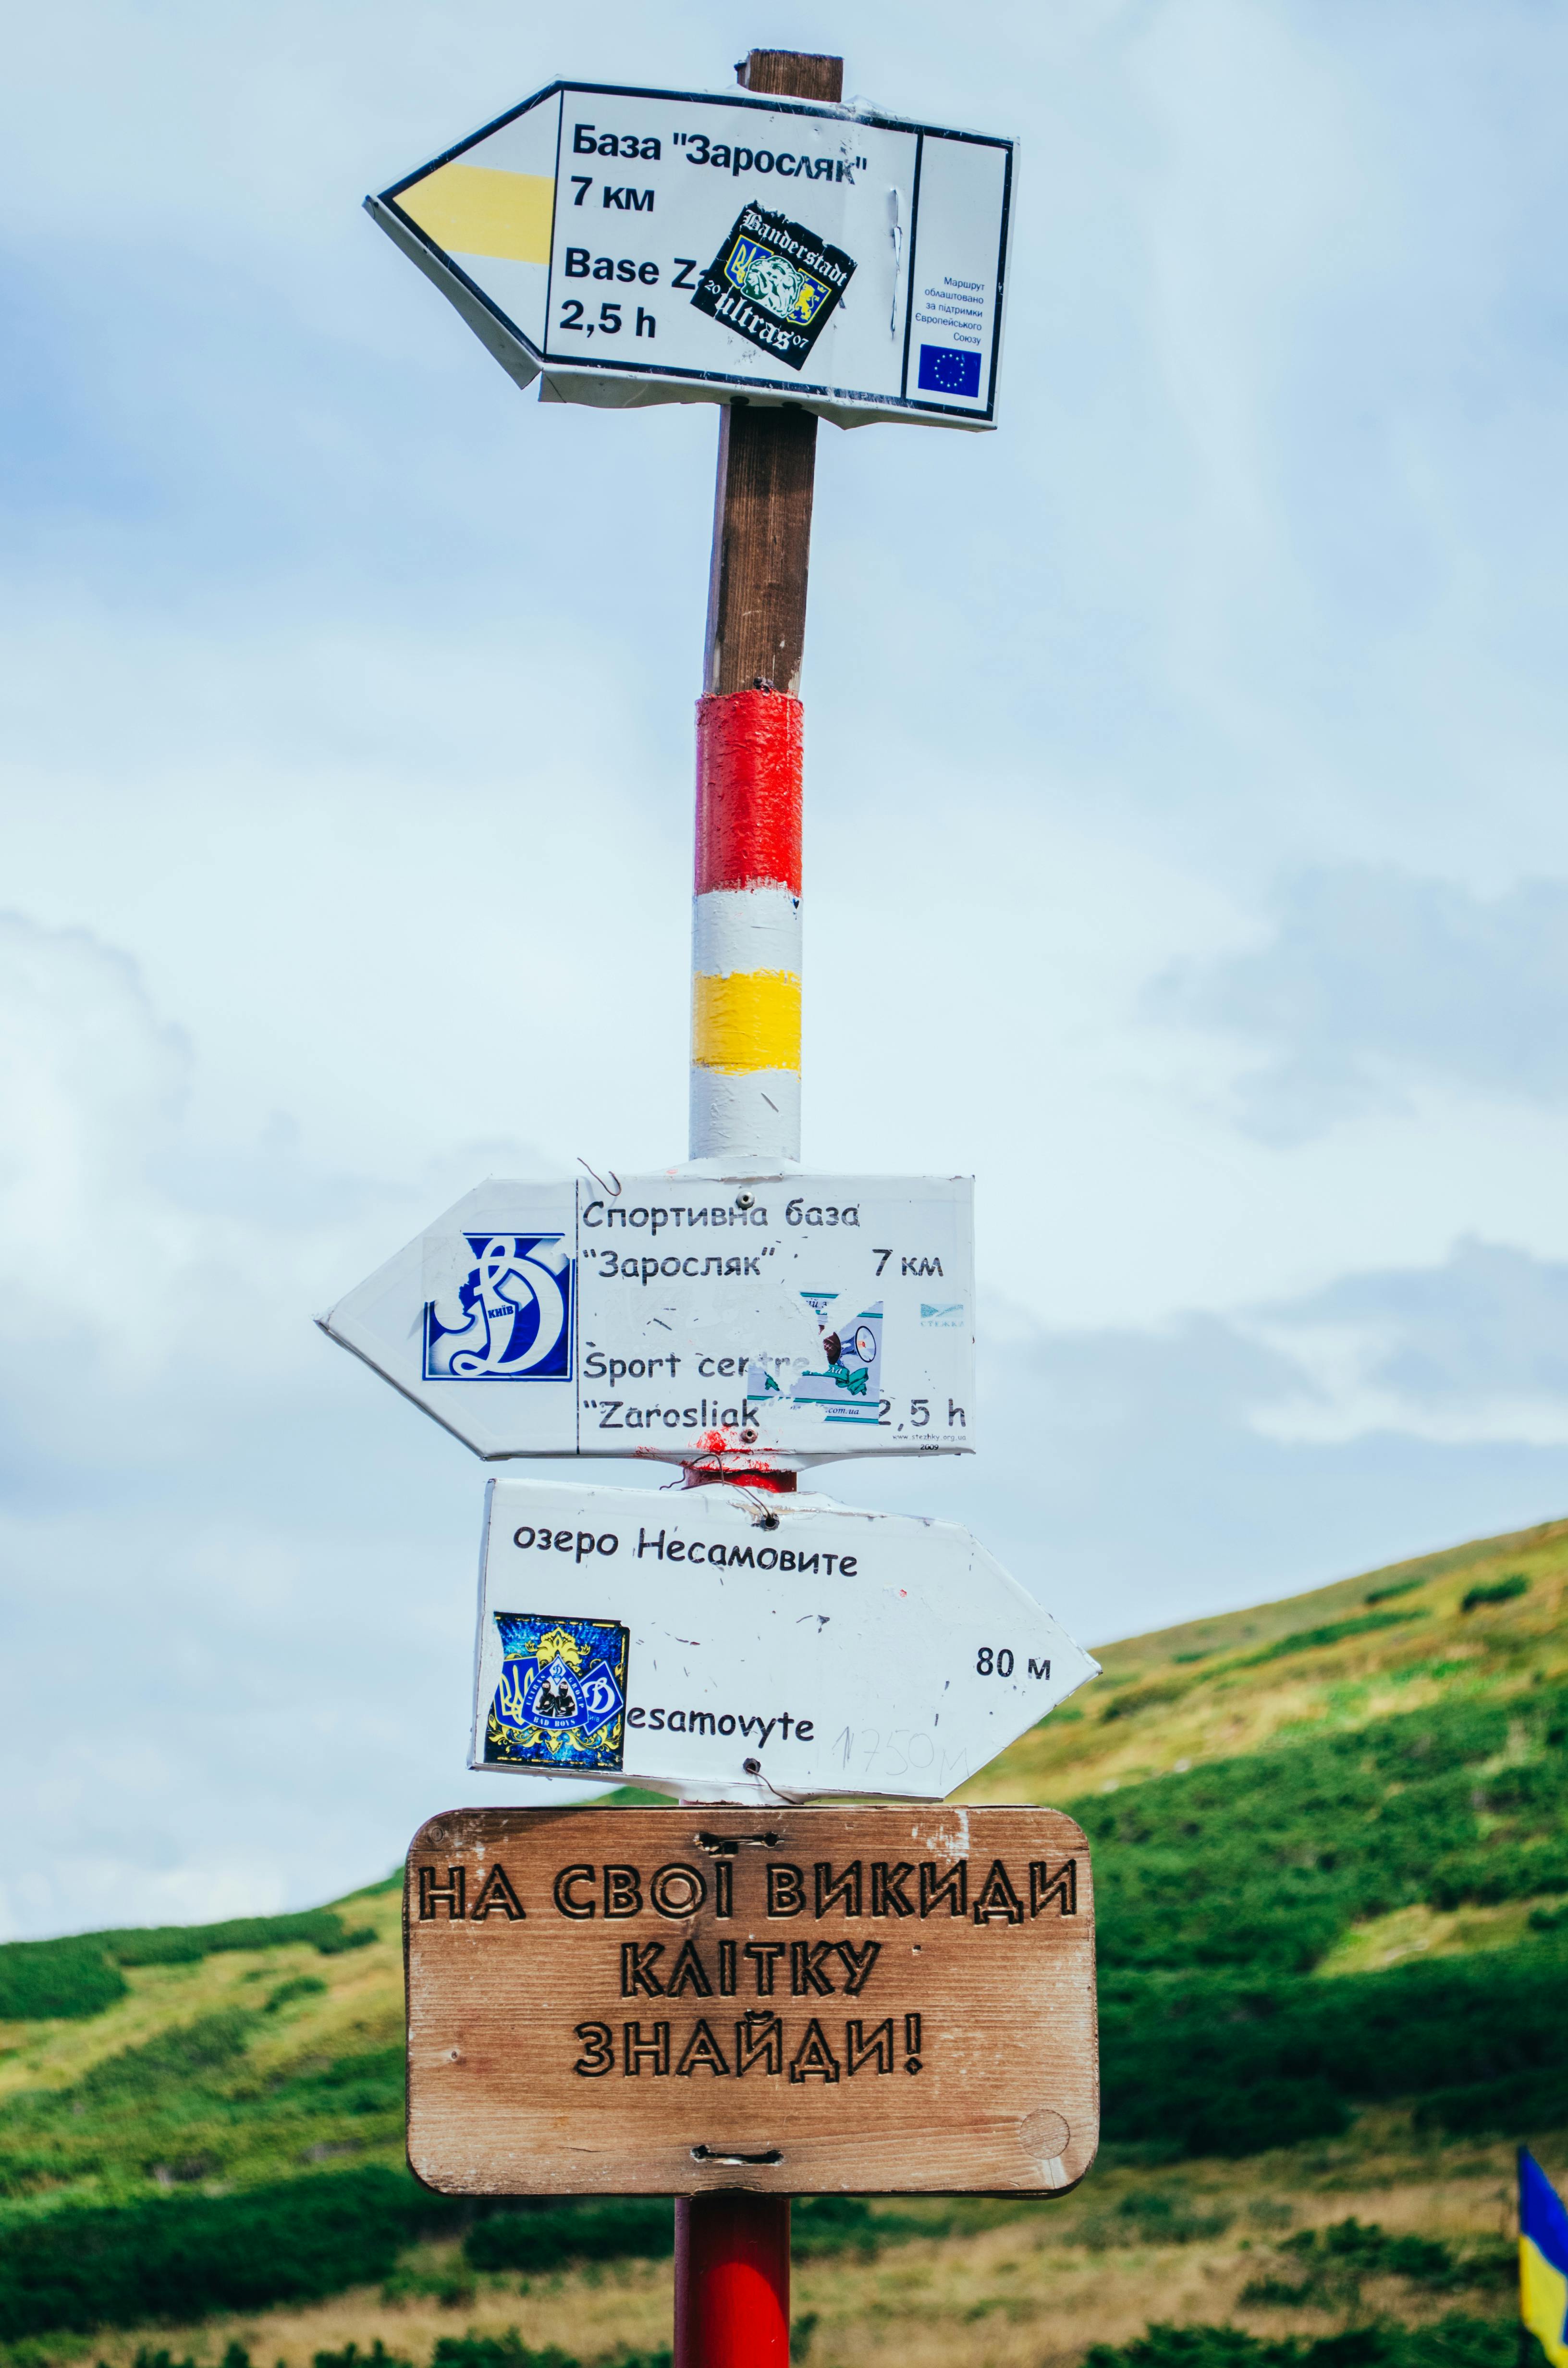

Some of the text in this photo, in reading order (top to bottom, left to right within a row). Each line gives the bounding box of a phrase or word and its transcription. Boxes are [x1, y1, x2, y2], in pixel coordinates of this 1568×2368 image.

[573, 123, 867, 185] База "Заросляк"
[571, 176, 655, 212] 7 км
[565, 247, 660, 285] Base
[740, 209, 847, 286] Banderstadt
[925, 288, 984, 304] облаштовано
[944, 277, 985, 291] Маршрут
[560, 300, 656, 338] 2,5 h
[704, 280, 809, 350] 20 ultras 07
[915, 313, 982, 331] Європейського
[926, 302, 983, 318] за підтримки
[954, 333, 981, 345] Союзу
[583, 1198, 860, 1236] Спортивна база
[583, 1247, 944, 1286] "Заросляк" 7 км
[583, 1352, 682, 1388] Sport
[879, 1399, 930, 1432] 2,5
[949, 1398, 966, 1427] h
[513, 1527, 858, 1577] озеро Несамовите
[976, 1647, 1014, 1677] 80
[568, 1677, 584, 1708] GROUP
[533, 1716, 575, 1727] BAD BOYS
[626, 1707, 814, 1749] esamovyte
[418, 1843, 1077, 1925] НА СВОЇ ВИКИДИ
[621, 1939, 882, 1998] КЛІТКУ
[574, 2010, 923, 2084] ЗНАЙДИ!
